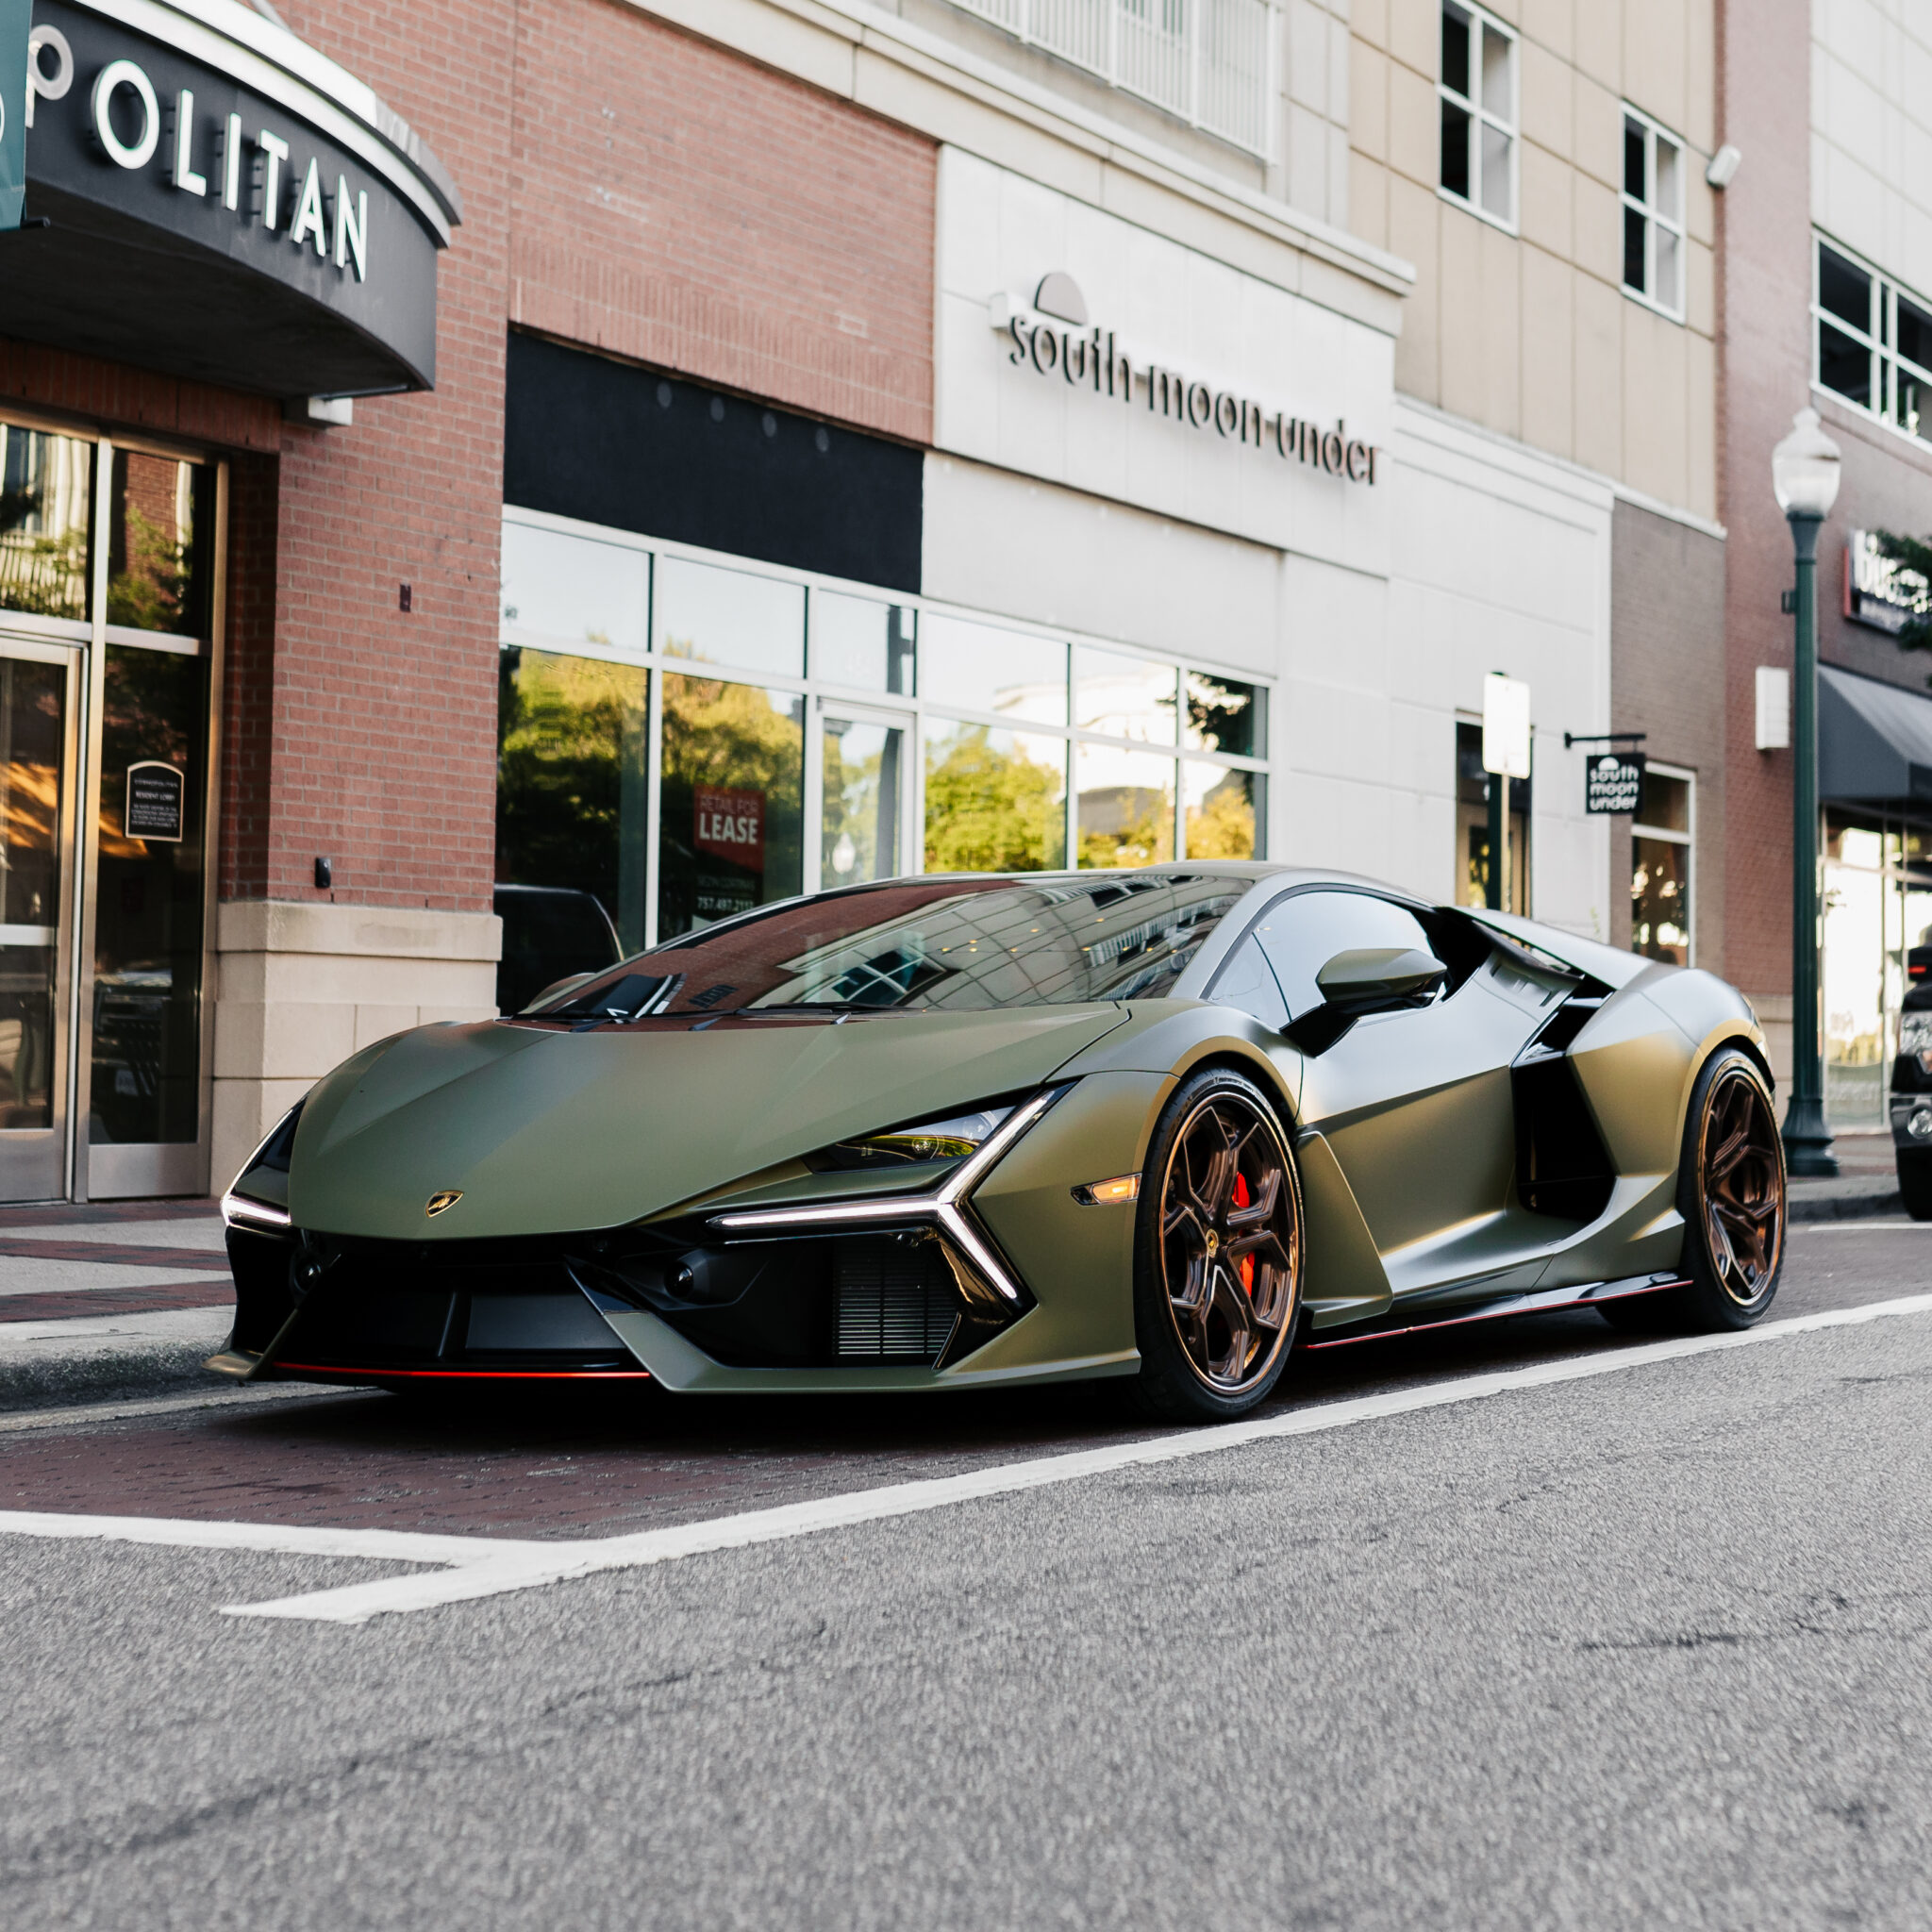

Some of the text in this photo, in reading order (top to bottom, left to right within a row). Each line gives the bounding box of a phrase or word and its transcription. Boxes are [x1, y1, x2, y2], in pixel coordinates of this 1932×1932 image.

[1009, 314, 1382, 487] south moon under
[1590, 765, 1639, 782] south
[1590, 781, 1639, 795] moon
[737, 798, 759, 815] FOR
[1590, 795, 1637, 810] under
[699, 813, 758, 844] LEASE
